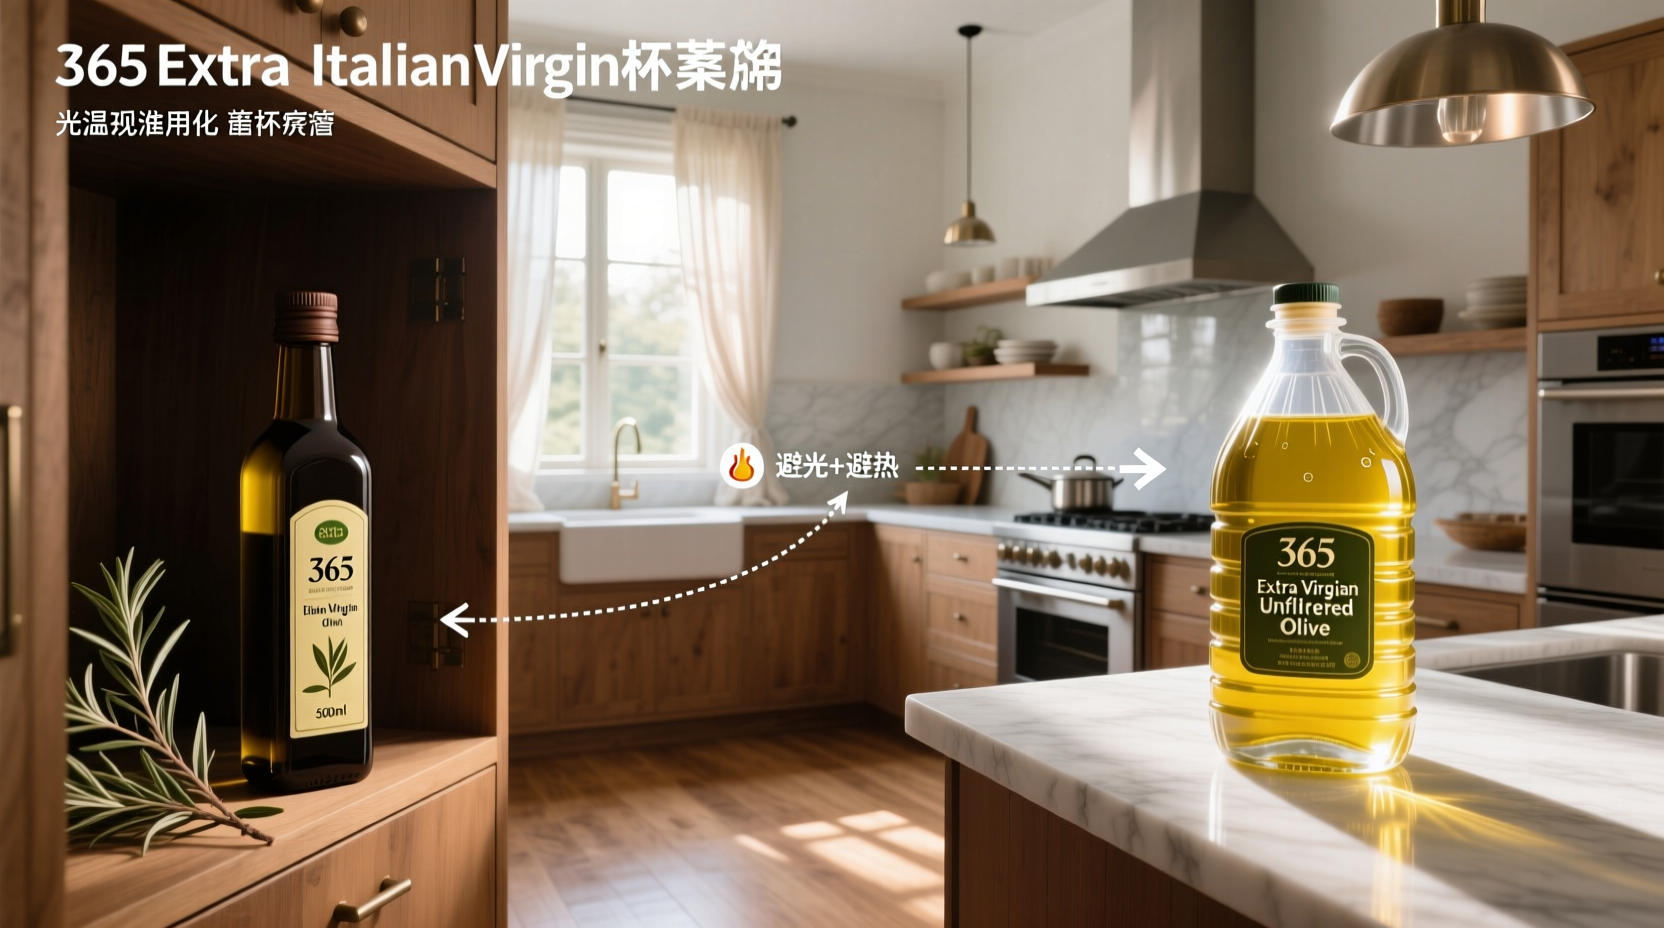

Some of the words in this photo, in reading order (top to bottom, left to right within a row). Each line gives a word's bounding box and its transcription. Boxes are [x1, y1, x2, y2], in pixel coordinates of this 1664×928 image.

[1277, 536, 1336, 569] 365
[308, 555, 354, 583] 365
[1257, 578, 1298, 595] Extra
[1300, 579, 1359, 600] Virgian
[1280, 617, 1331, 637] Olive
